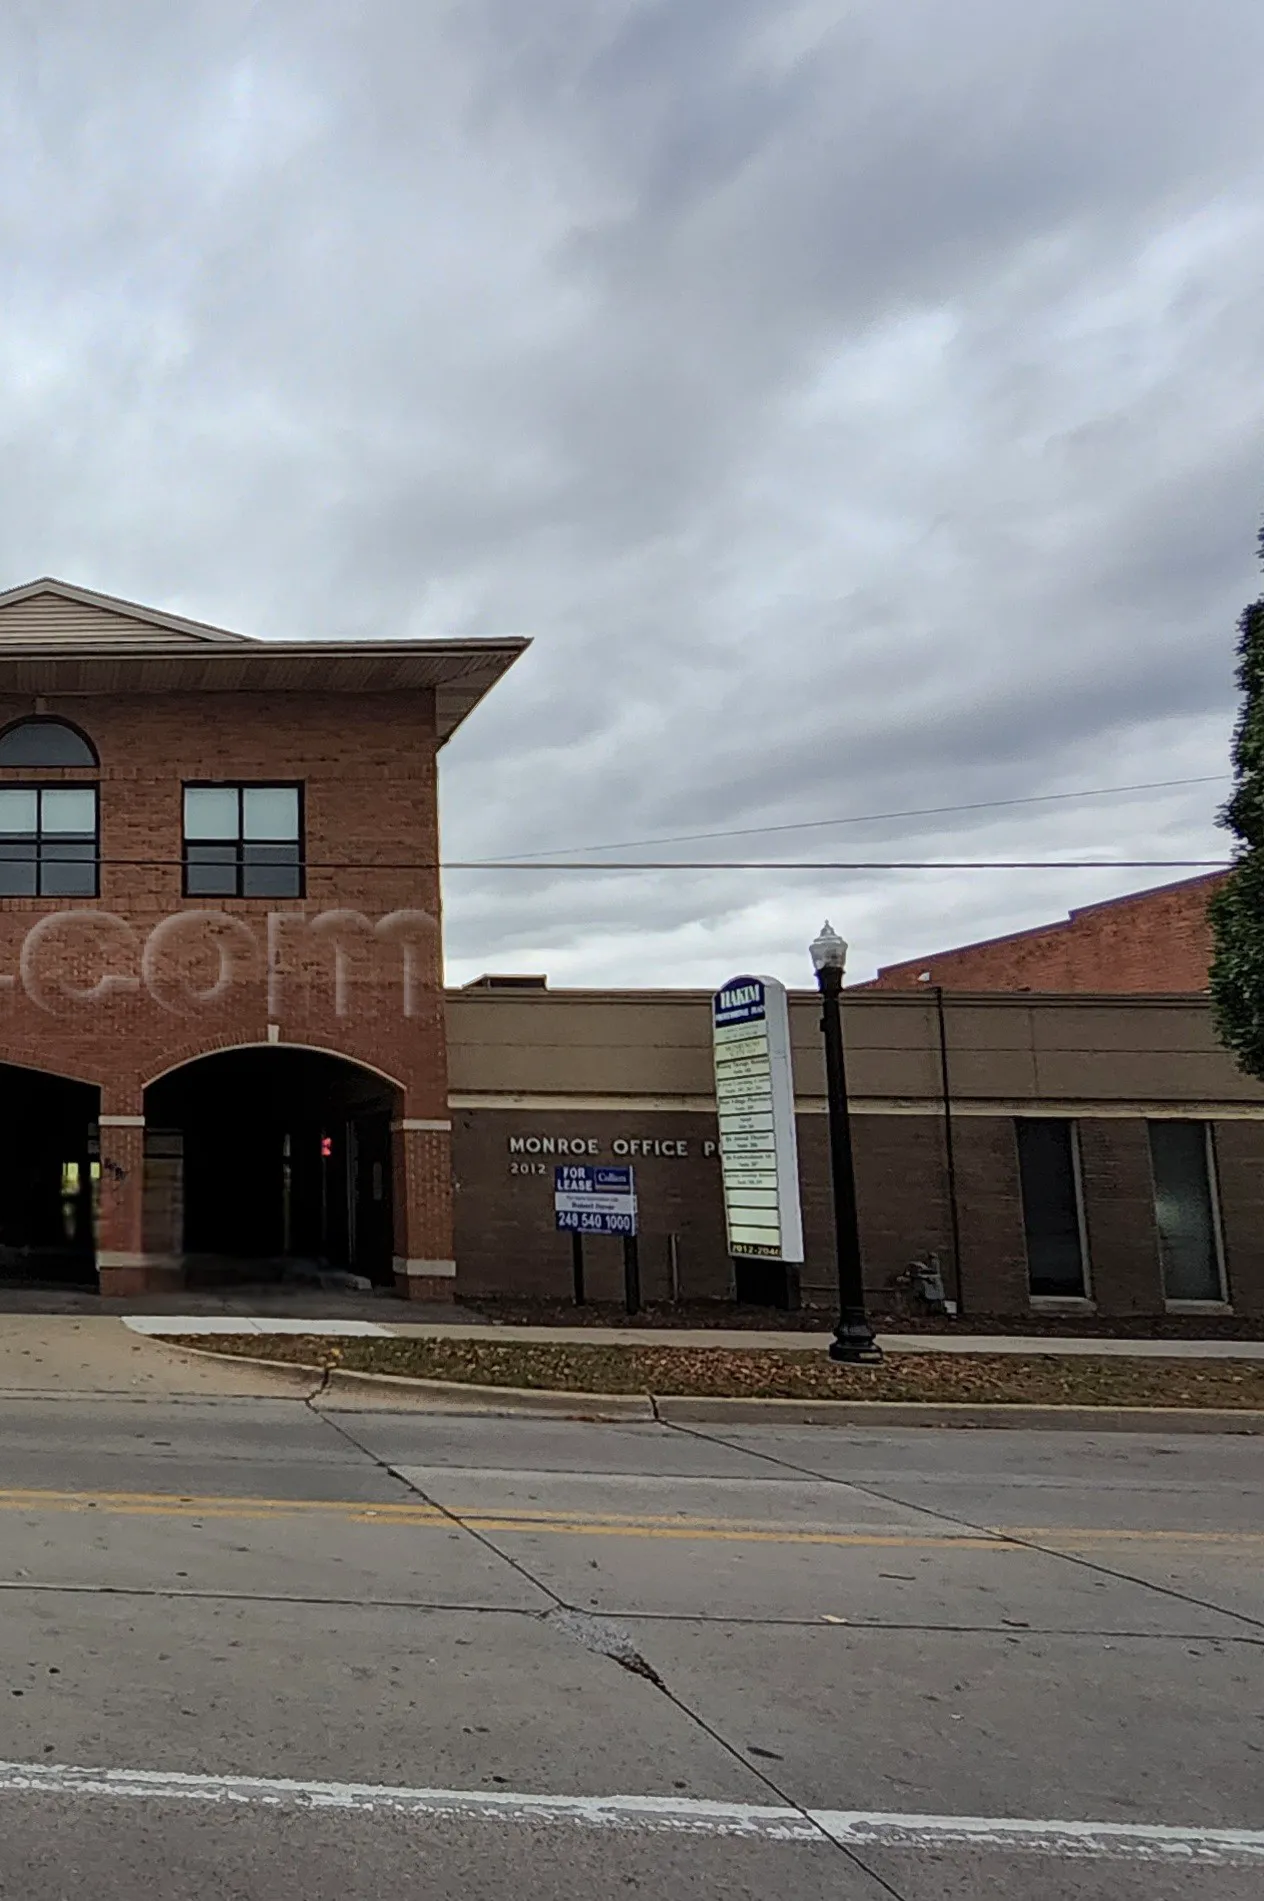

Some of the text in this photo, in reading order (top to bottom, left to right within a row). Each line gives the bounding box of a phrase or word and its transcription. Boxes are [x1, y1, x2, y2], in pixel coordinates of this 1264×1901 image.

[510, 1136, 599, 1156] MONROE
[612, 1139, 688, 1157] OFFICE
[510, 1162, 547, 1176] 2012
[563, 1166, 586, 1179] FOR
[557, 1179, 593, 1192] LEASE
[558, 1212, 579, 1228] 248
[581, 1213, 602, 1229] 540
[605, 1214, 631, 1232] 1000
